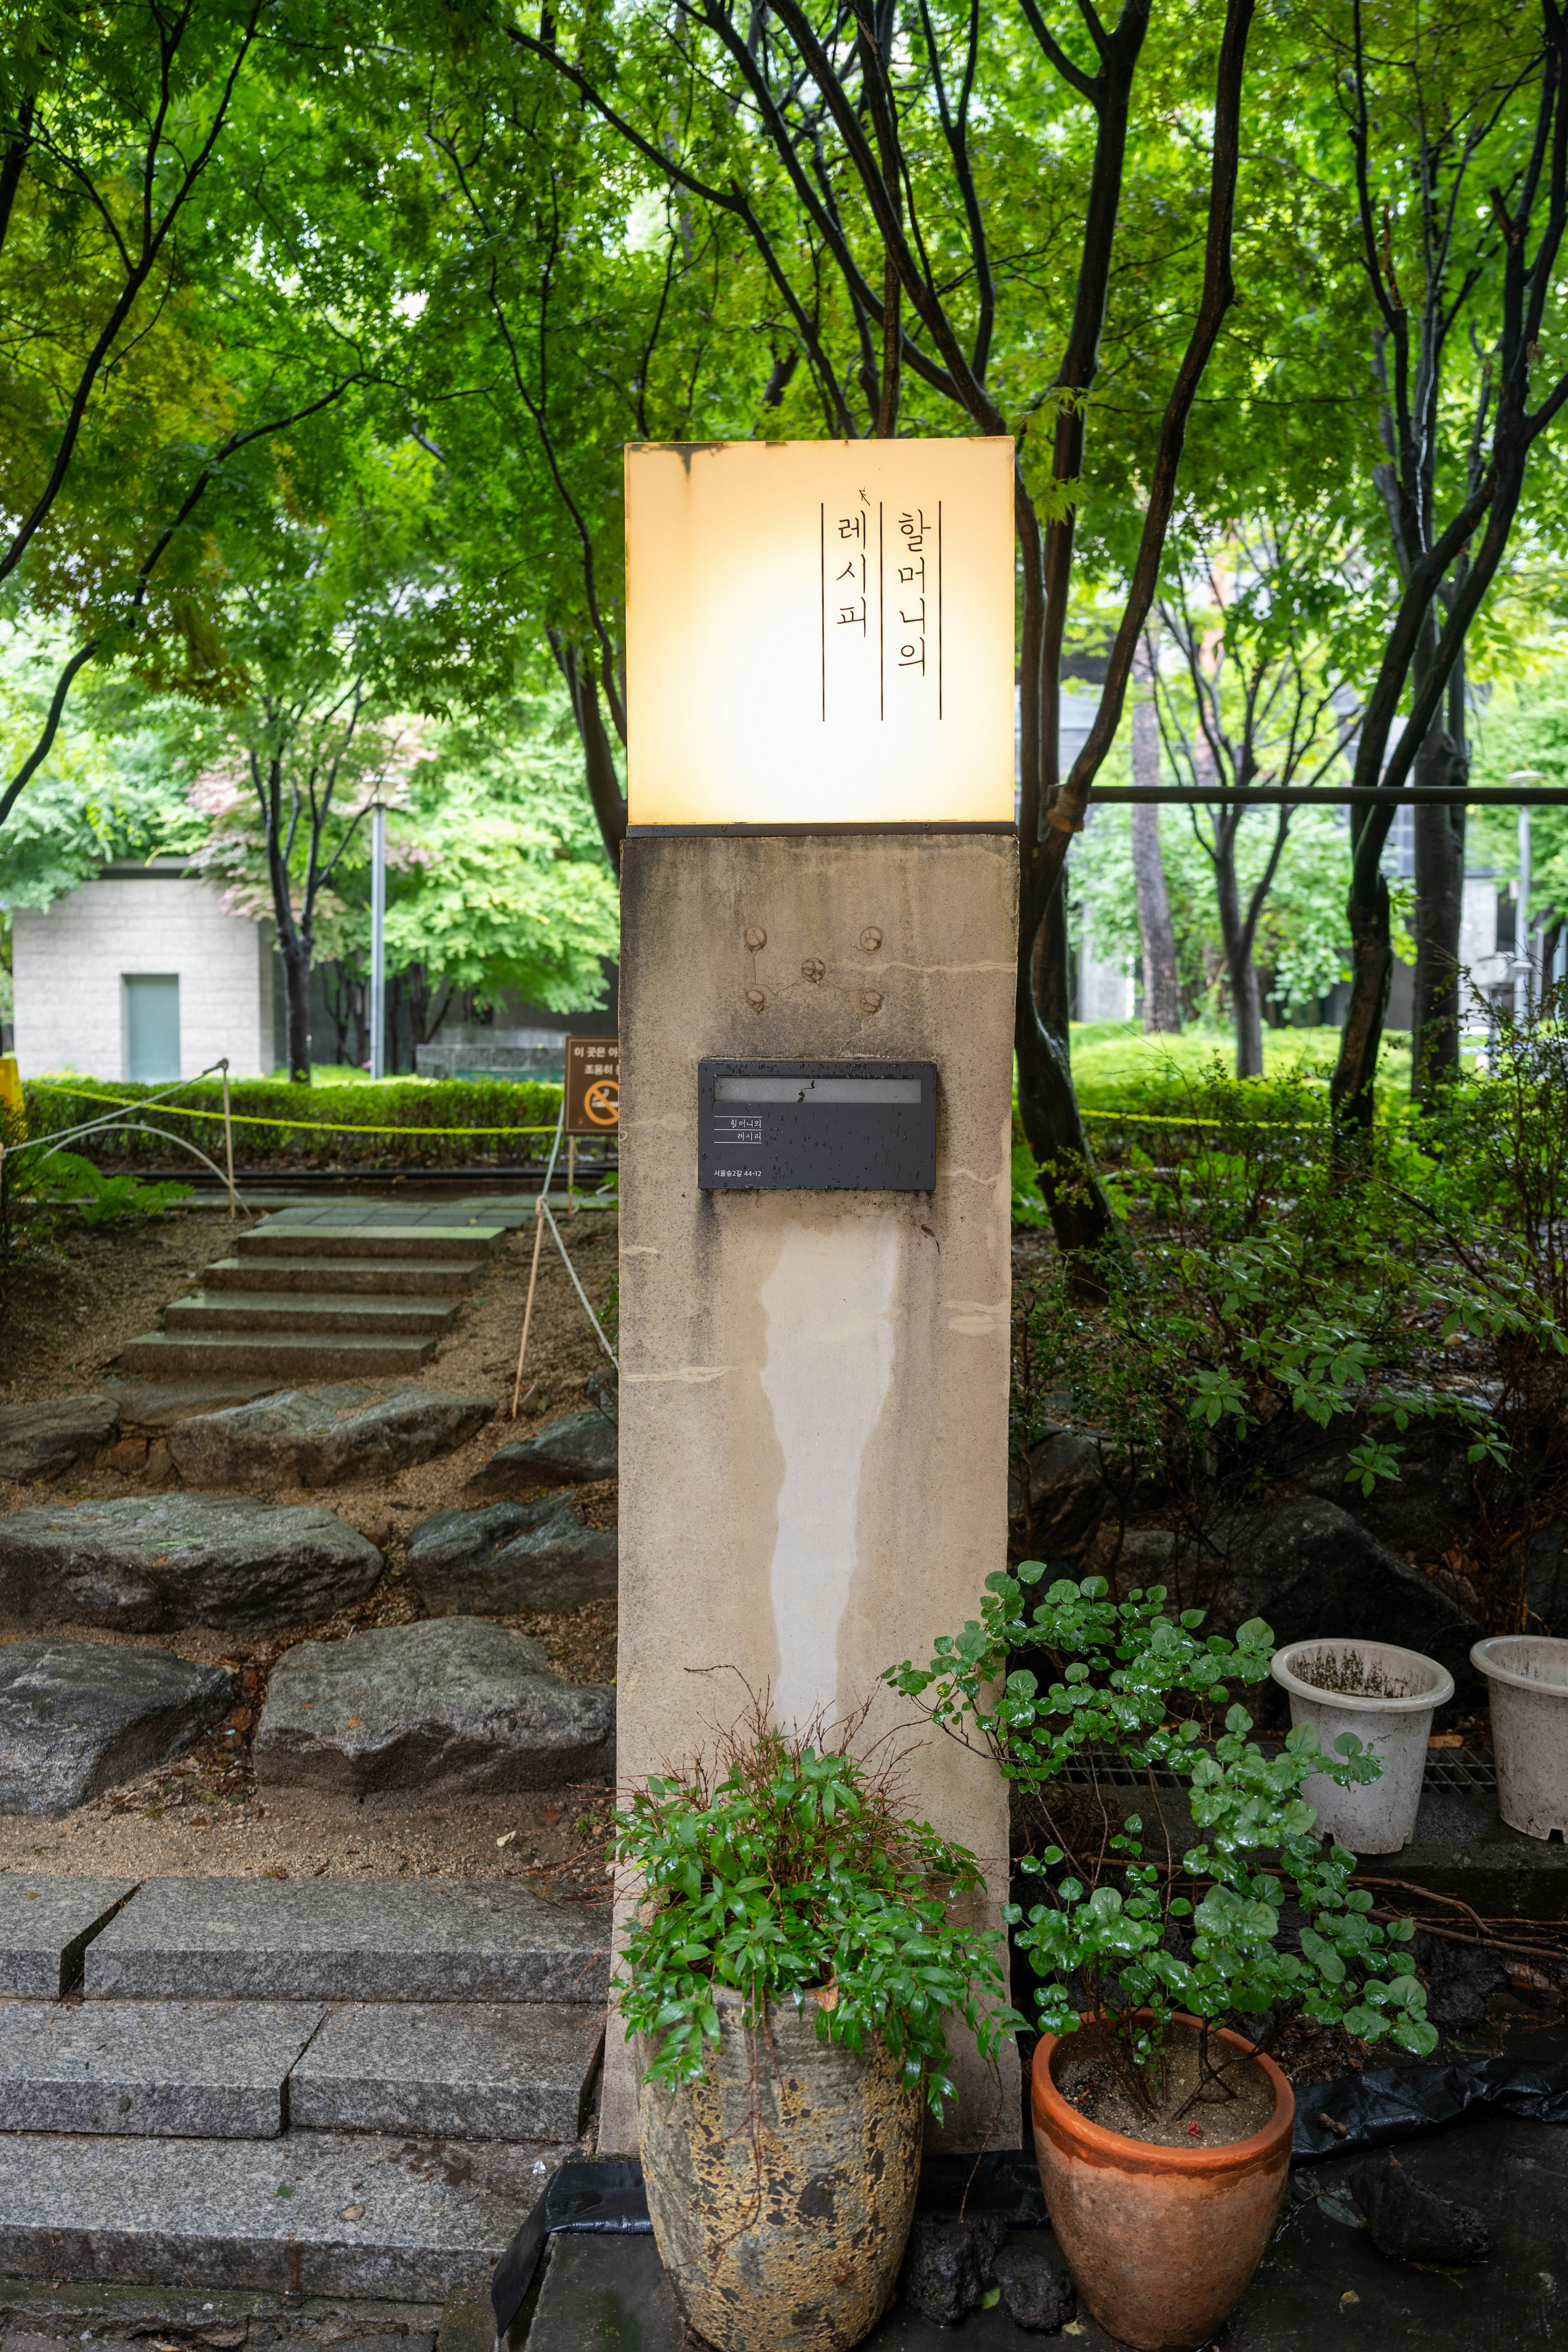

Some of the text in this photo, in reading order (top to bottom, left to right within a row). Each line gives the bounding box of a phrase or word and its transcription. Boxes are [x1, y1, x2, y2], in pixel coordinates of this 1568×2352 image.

[835, 510, 865, 637] 레시피
[898, 509, 931, 677] 할머니의
[573, 1046, 584, 1058] 이
[587, 1046, 606, 1058] 곳은
[584, 1064, 613, 1075] 조용히
[737, 1132, 761, 1142] 레시피
